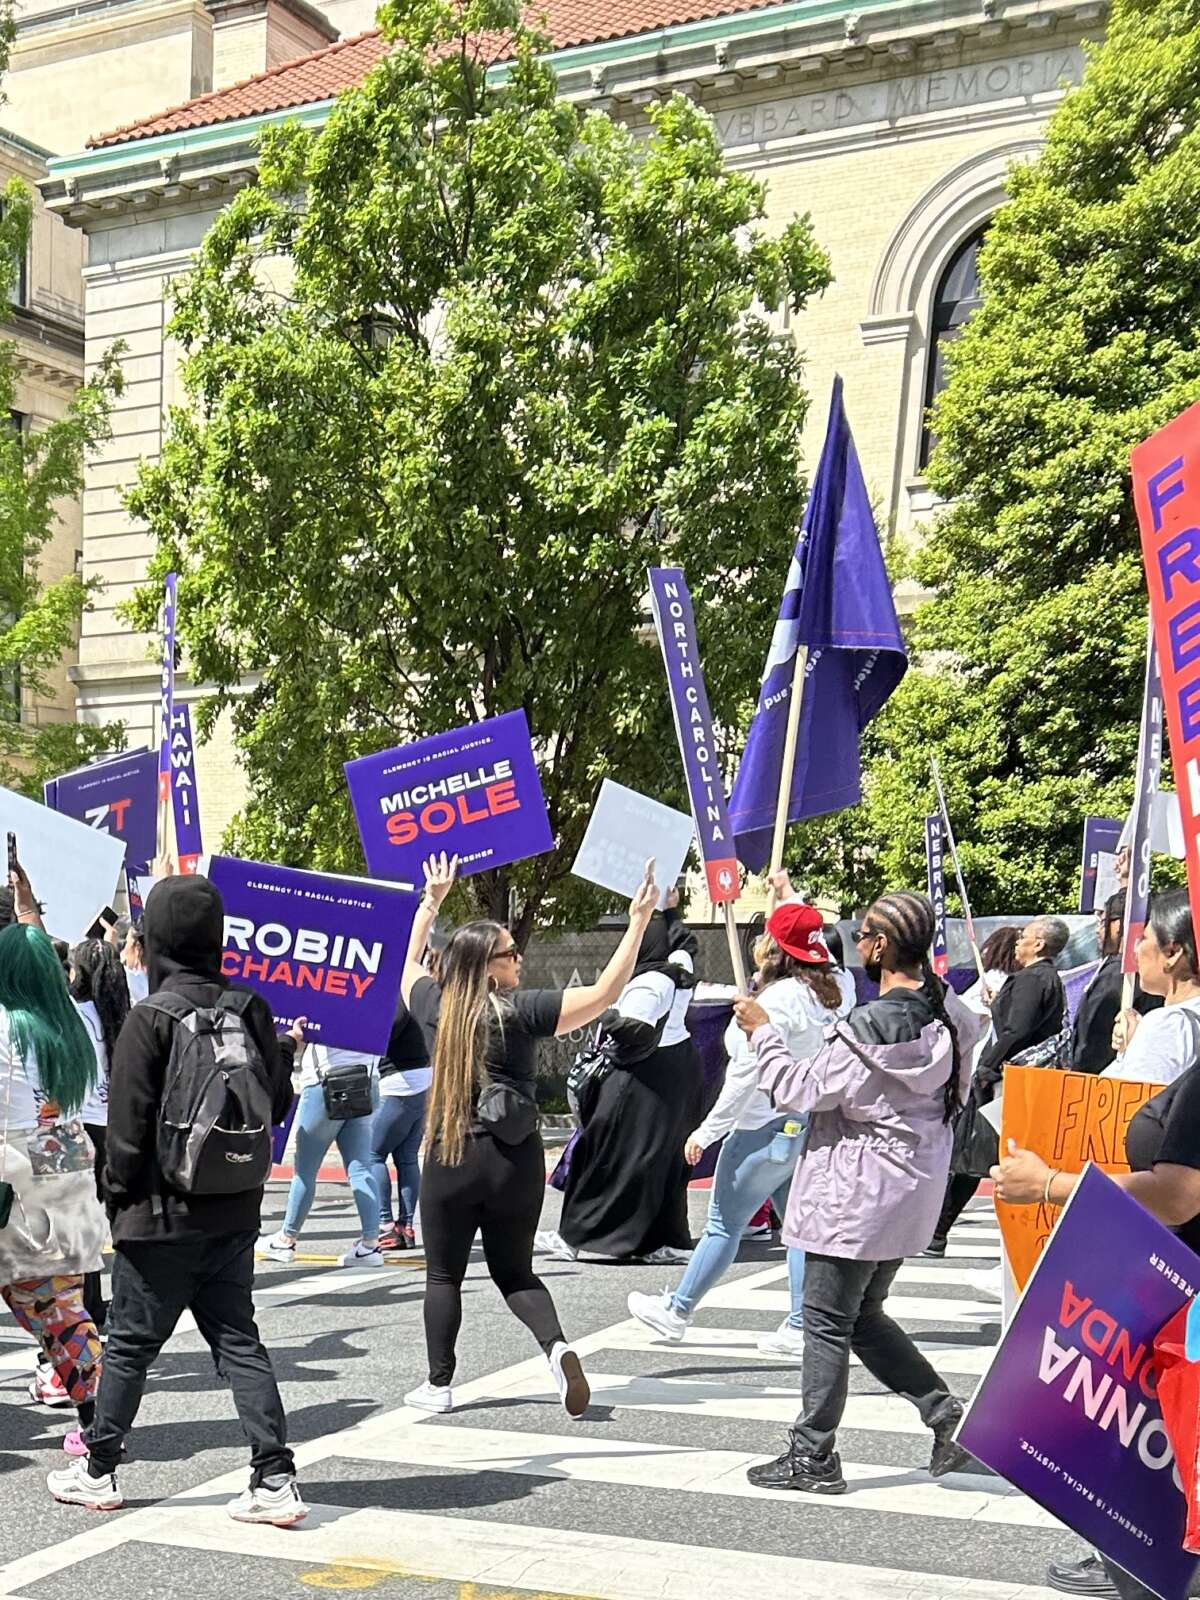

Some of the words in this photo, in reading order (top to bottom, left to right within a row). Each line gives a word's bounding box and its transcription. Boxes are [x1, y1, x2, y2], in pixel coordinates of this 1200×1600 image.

[892, 55, 1075, 110] MEMORIA
[663, 582, 693, 678] NORTH
[685, 686, 724, 842] CAROLINA
[170, 711, 193, 826] HAWAII
[432, 746, 460, 760] RACIAL
[380, 759, 513, 815] MICHELLE
[386, 779, 521, 845] SOLE
[247, 880, 291, 895] CLEMENCY
[305, 890, 334, 903] RACIAL
[930, 823, 945, 947] NEBRASKA
[223, 915, 382, 975] ROBIN
[220, 950, 376, 999] CHANEY
[1053, 1073, 1168, 1166] FRE
[1149, 1252, 1197, 1298] REEHER
[1058, 1281, 1158, 1400] ONDA
[1038, 1326, 1186, 1494] ONNA
[1062, 1471, 1096, 1502] RACIAL
[1106, 1509, 1154, 1546] CLEMENCY
